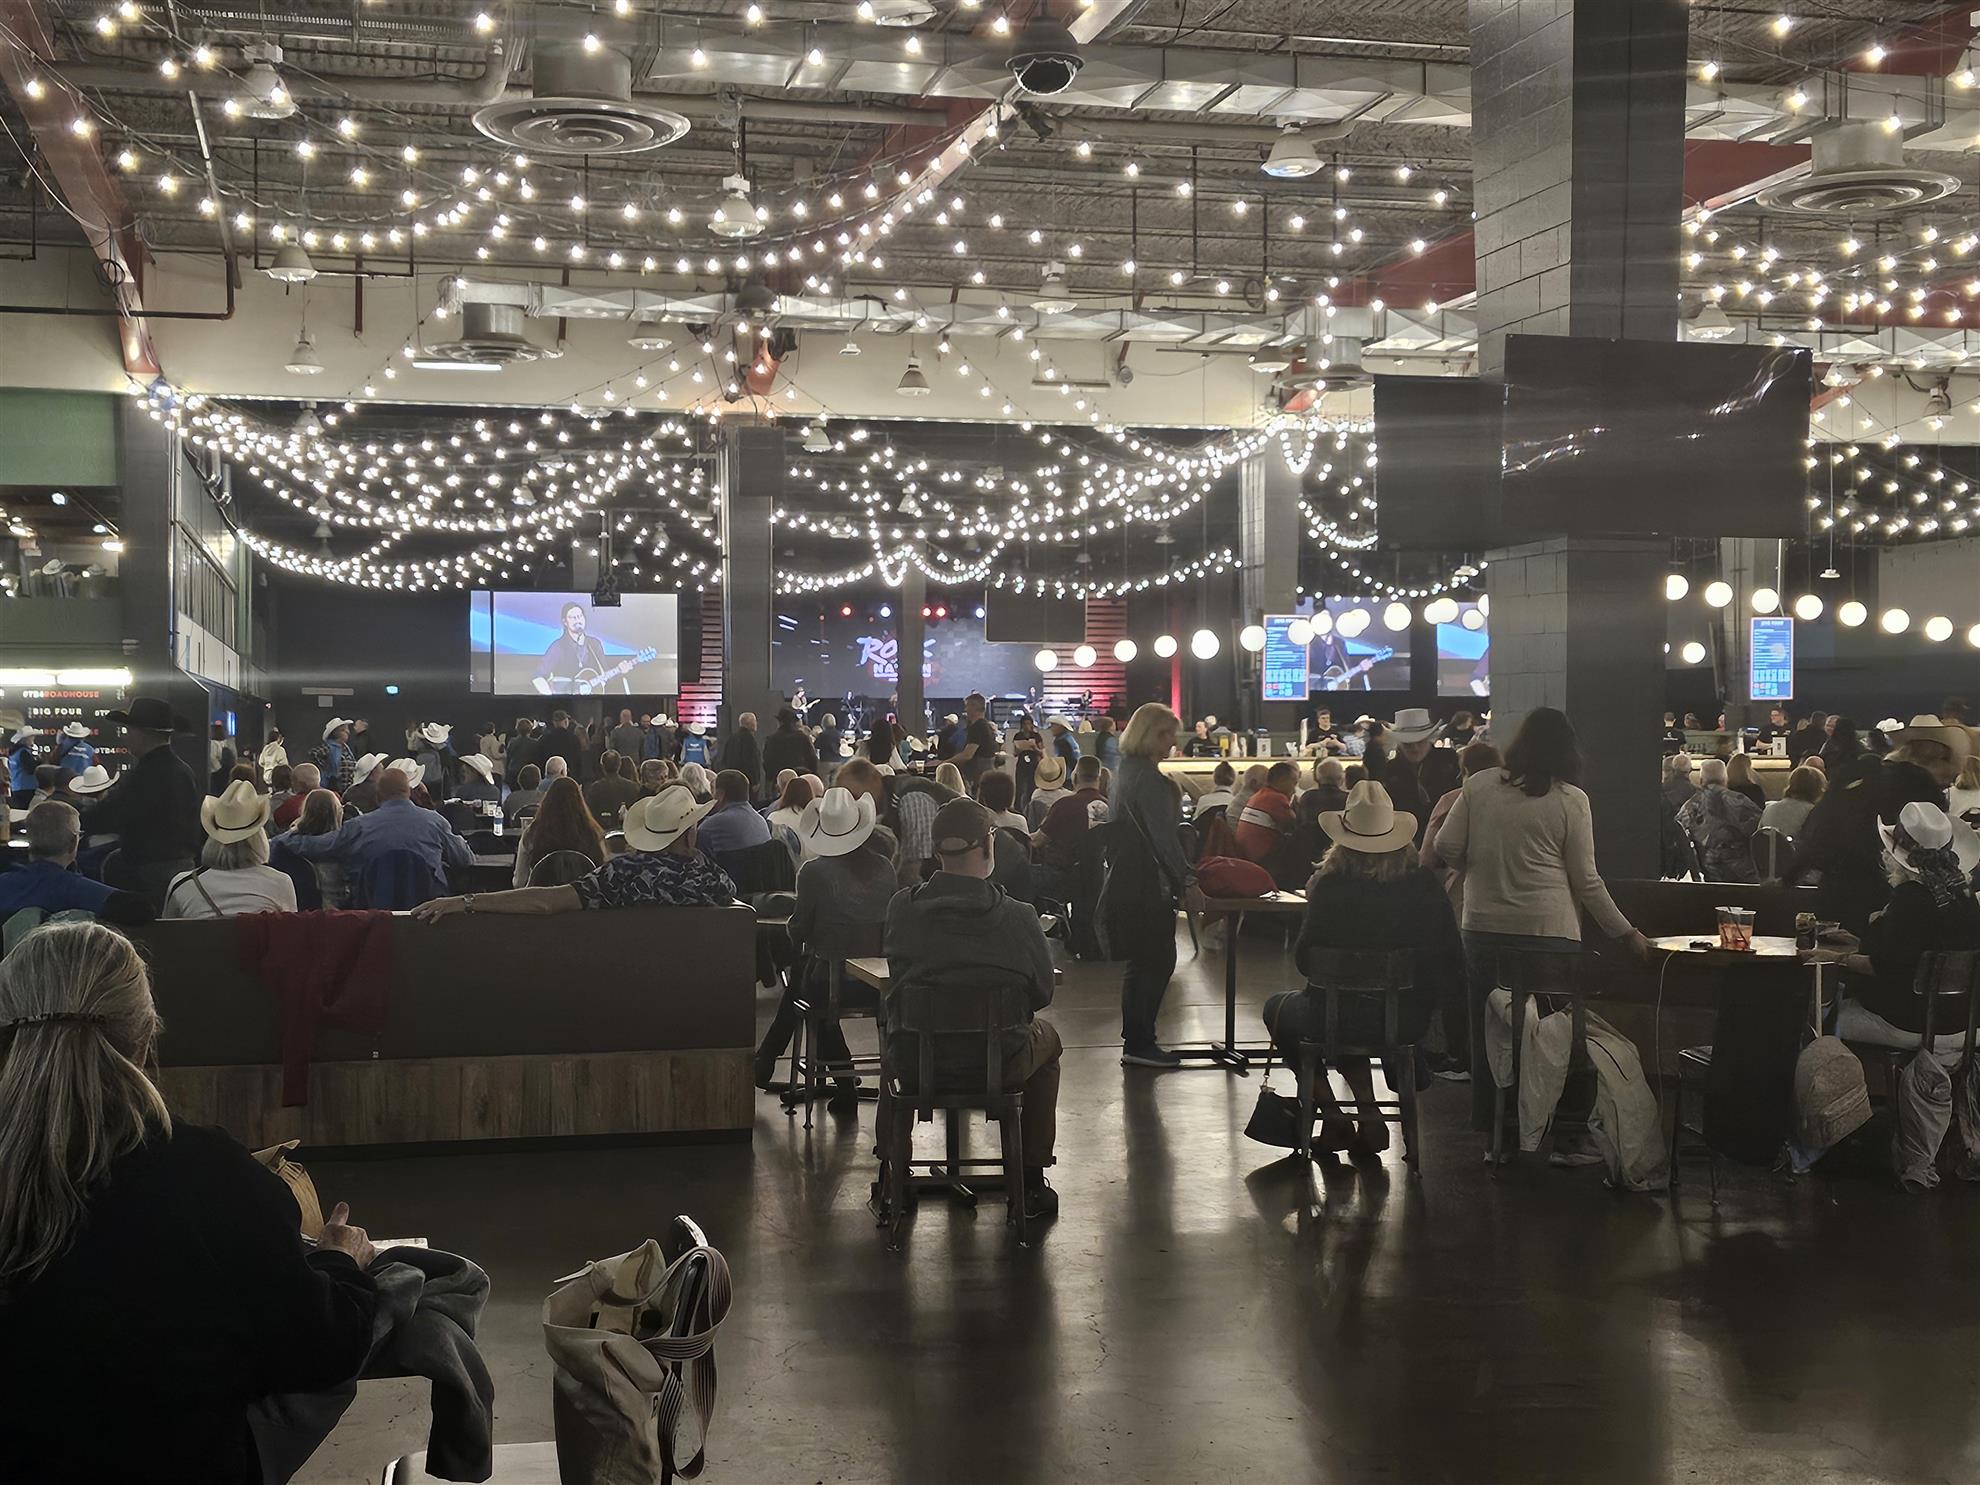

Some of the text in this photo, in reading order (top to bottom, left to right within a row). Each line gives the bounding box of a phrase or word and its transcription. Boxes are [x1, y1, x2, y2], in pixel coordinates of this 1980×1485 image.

[856, 636, 937, 666] ROK
[32, 707, 51, 715] BIG
[54, 707, 82, 715] FOUR
